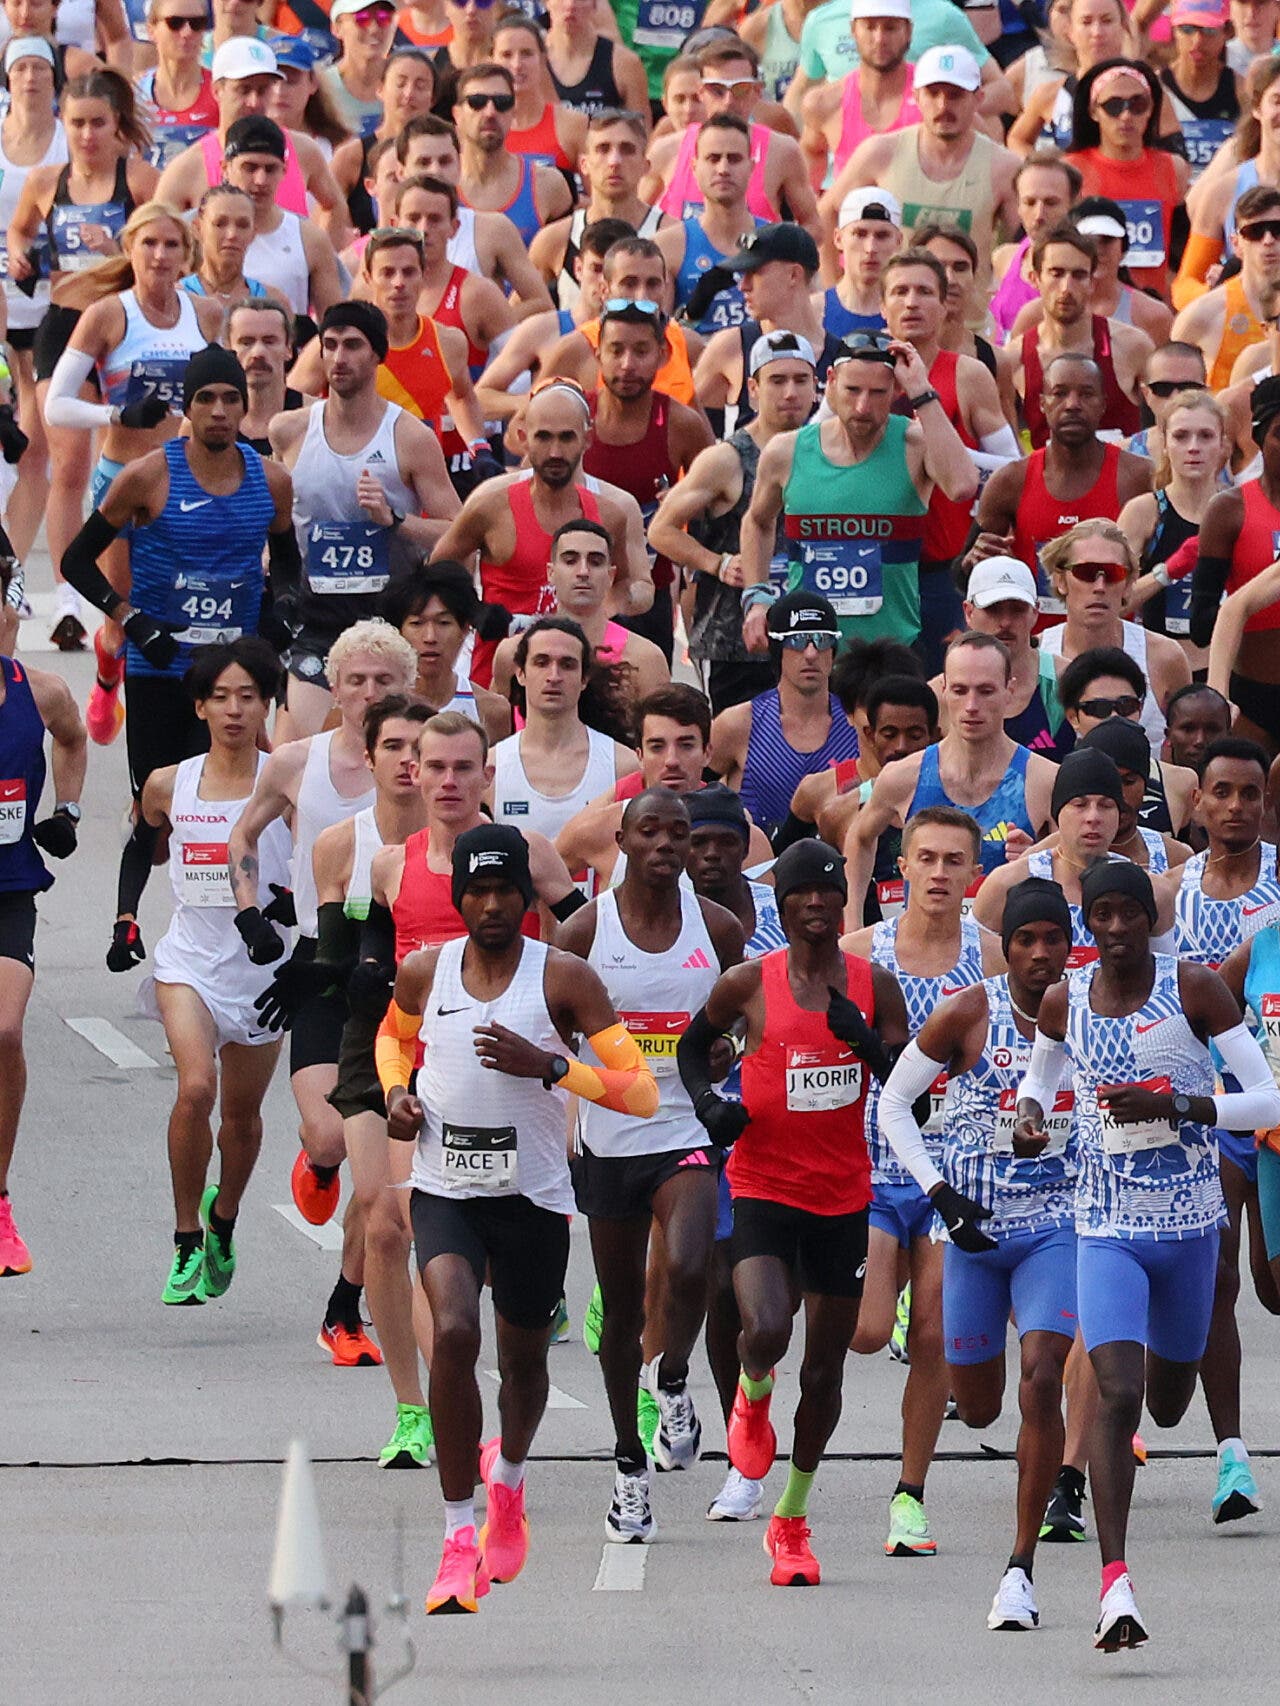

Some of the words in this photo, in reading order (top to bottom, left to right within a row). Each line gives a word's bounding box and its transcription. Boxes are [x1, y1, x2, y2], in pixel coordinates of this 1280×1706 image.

[713, 302, 751, 327] 45
[800, 518, 893, 537] STROUD
[321, 545, 374, 569] 478
[815, 566, 868, 590] 690
[181, 596, 233, 620] 494
[175, 815, 229, 824] HONDA
[185, 871, 229, 882] MATSUM
[789, 1073, 795, 1094] J
[803, 1068, 858, 1089] KORIR
[1000, 1117, 1069, 1129] MMED
[446, 1151, 494, 1170] PACE
[501, 1153, 509, 1169] 1
